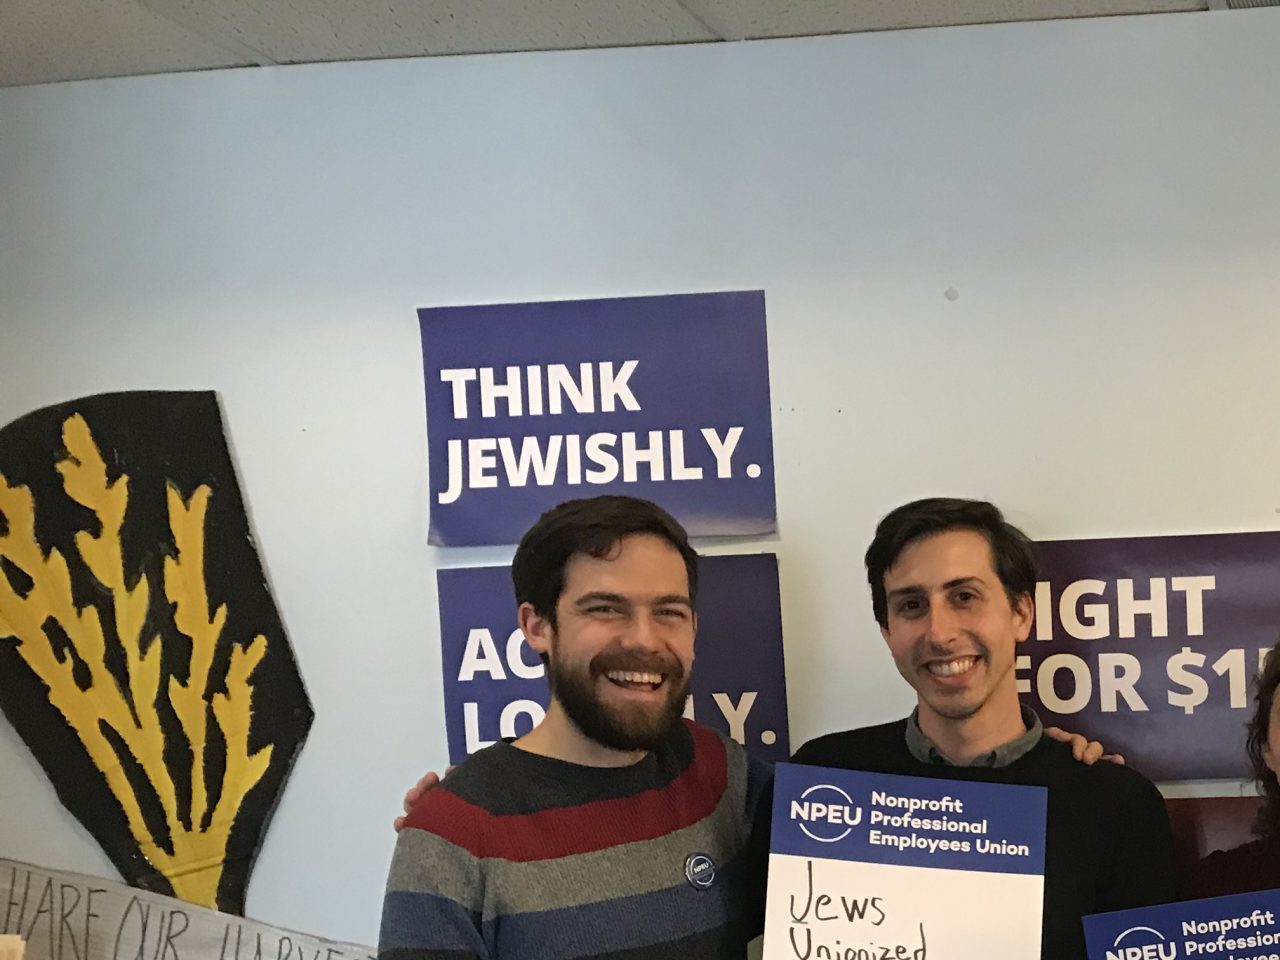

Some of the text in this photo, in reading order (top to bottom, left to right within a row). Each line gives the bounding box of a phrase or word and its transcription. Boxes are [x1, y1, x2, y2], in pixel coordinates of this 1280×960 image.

[440, 360, 641, 419] THINK
[439, 427, 762, 504] JEWISHLY.
[1035, 575, 1215, 640] IGHT
[1166, 647, 1275, 714] $1
[790, 800, 862, 825] NPEU
[870, 811, 987, 834] Professional
[872, 791, 963, 813] Nonprofit
[869, 830, 1029, 857] Employees Union
[791, 860, 886, 925] Jews
[1182, 910, 1275, 936] Nonprofit
